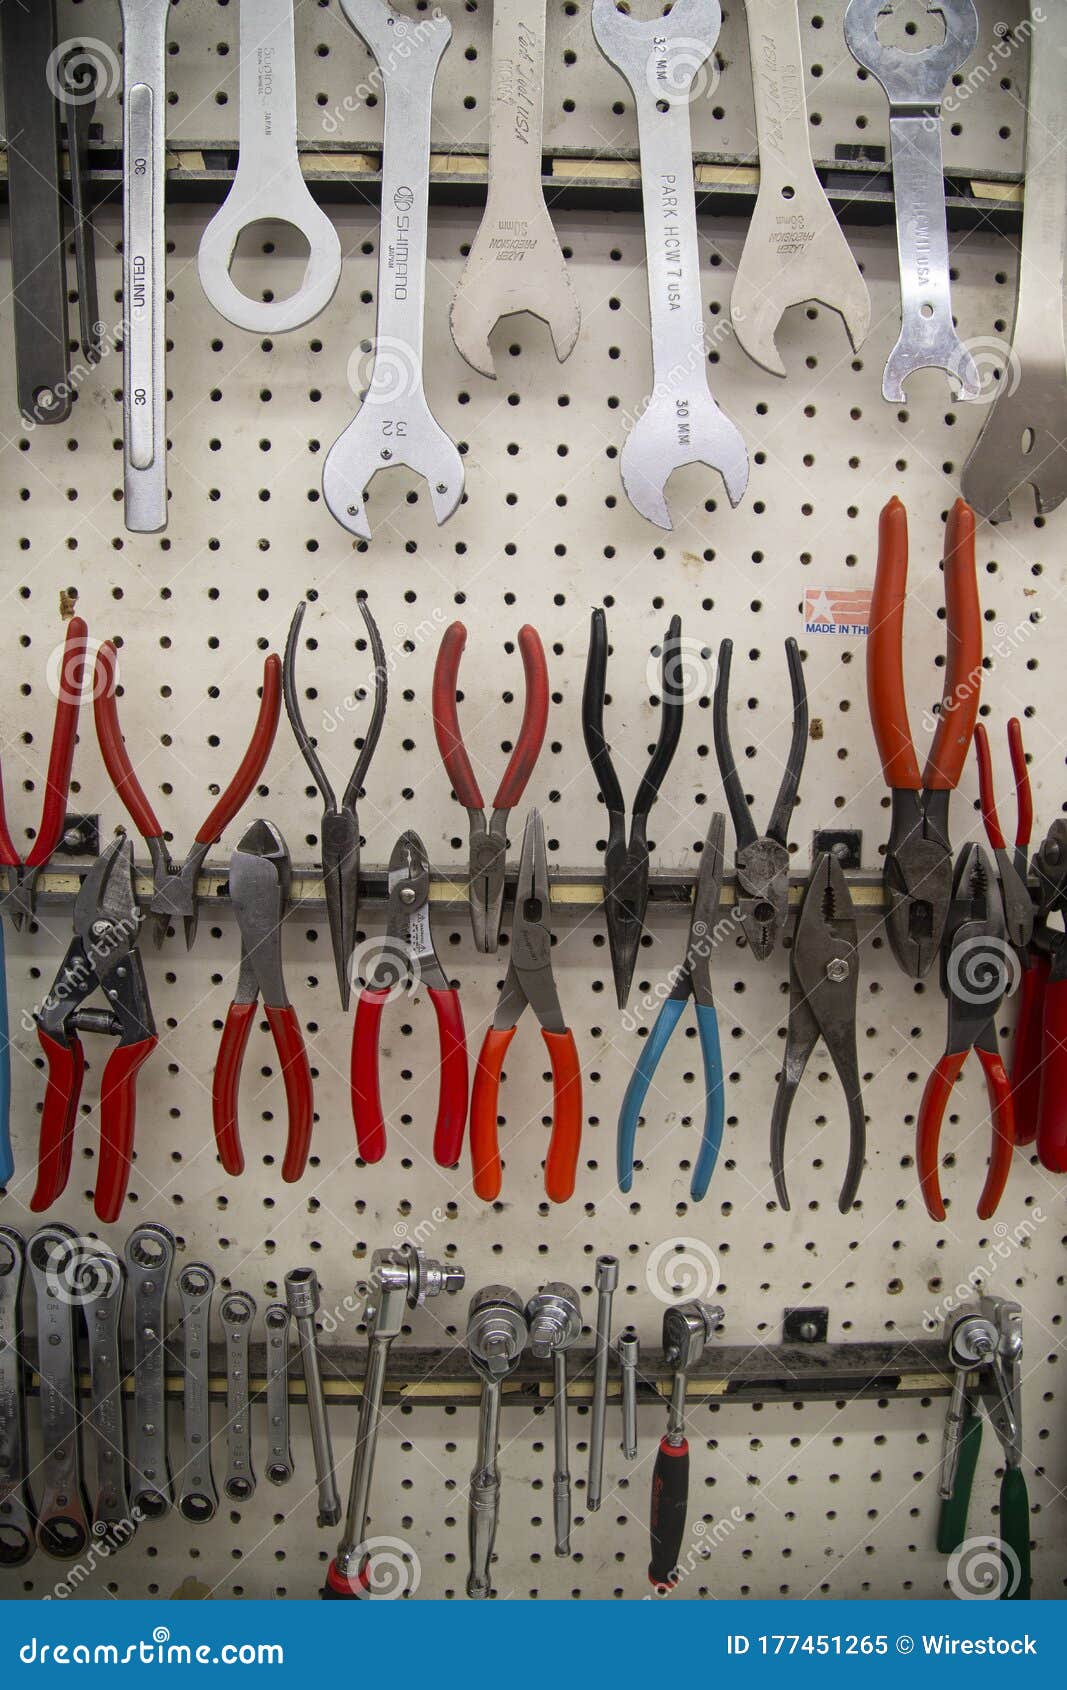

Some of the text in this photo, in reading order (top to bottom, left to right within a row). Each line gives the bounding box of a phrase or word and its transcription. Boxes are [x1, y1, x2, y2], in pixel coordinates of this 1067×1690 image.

[653, 36, 668, 81] 32 MM
[134, 157, 148, 176] 30
[488, 237, 538, 250] PRECISION
[660, 174, 683, 312] PARK HCW 7 USA
[768, 231, 816, 243] PRECISION
[387, 245, 395, 269] JAPAN
[394, 215, 411, 301] SHIMANO
[133, 255, 147, 308] UNITED
[134, 387, 147, 406] 30
[381, 419, 408, 438] 32
[675, 399, 691, 446] 30 MM
[805, 623, 869, 635] MADE IN TH
